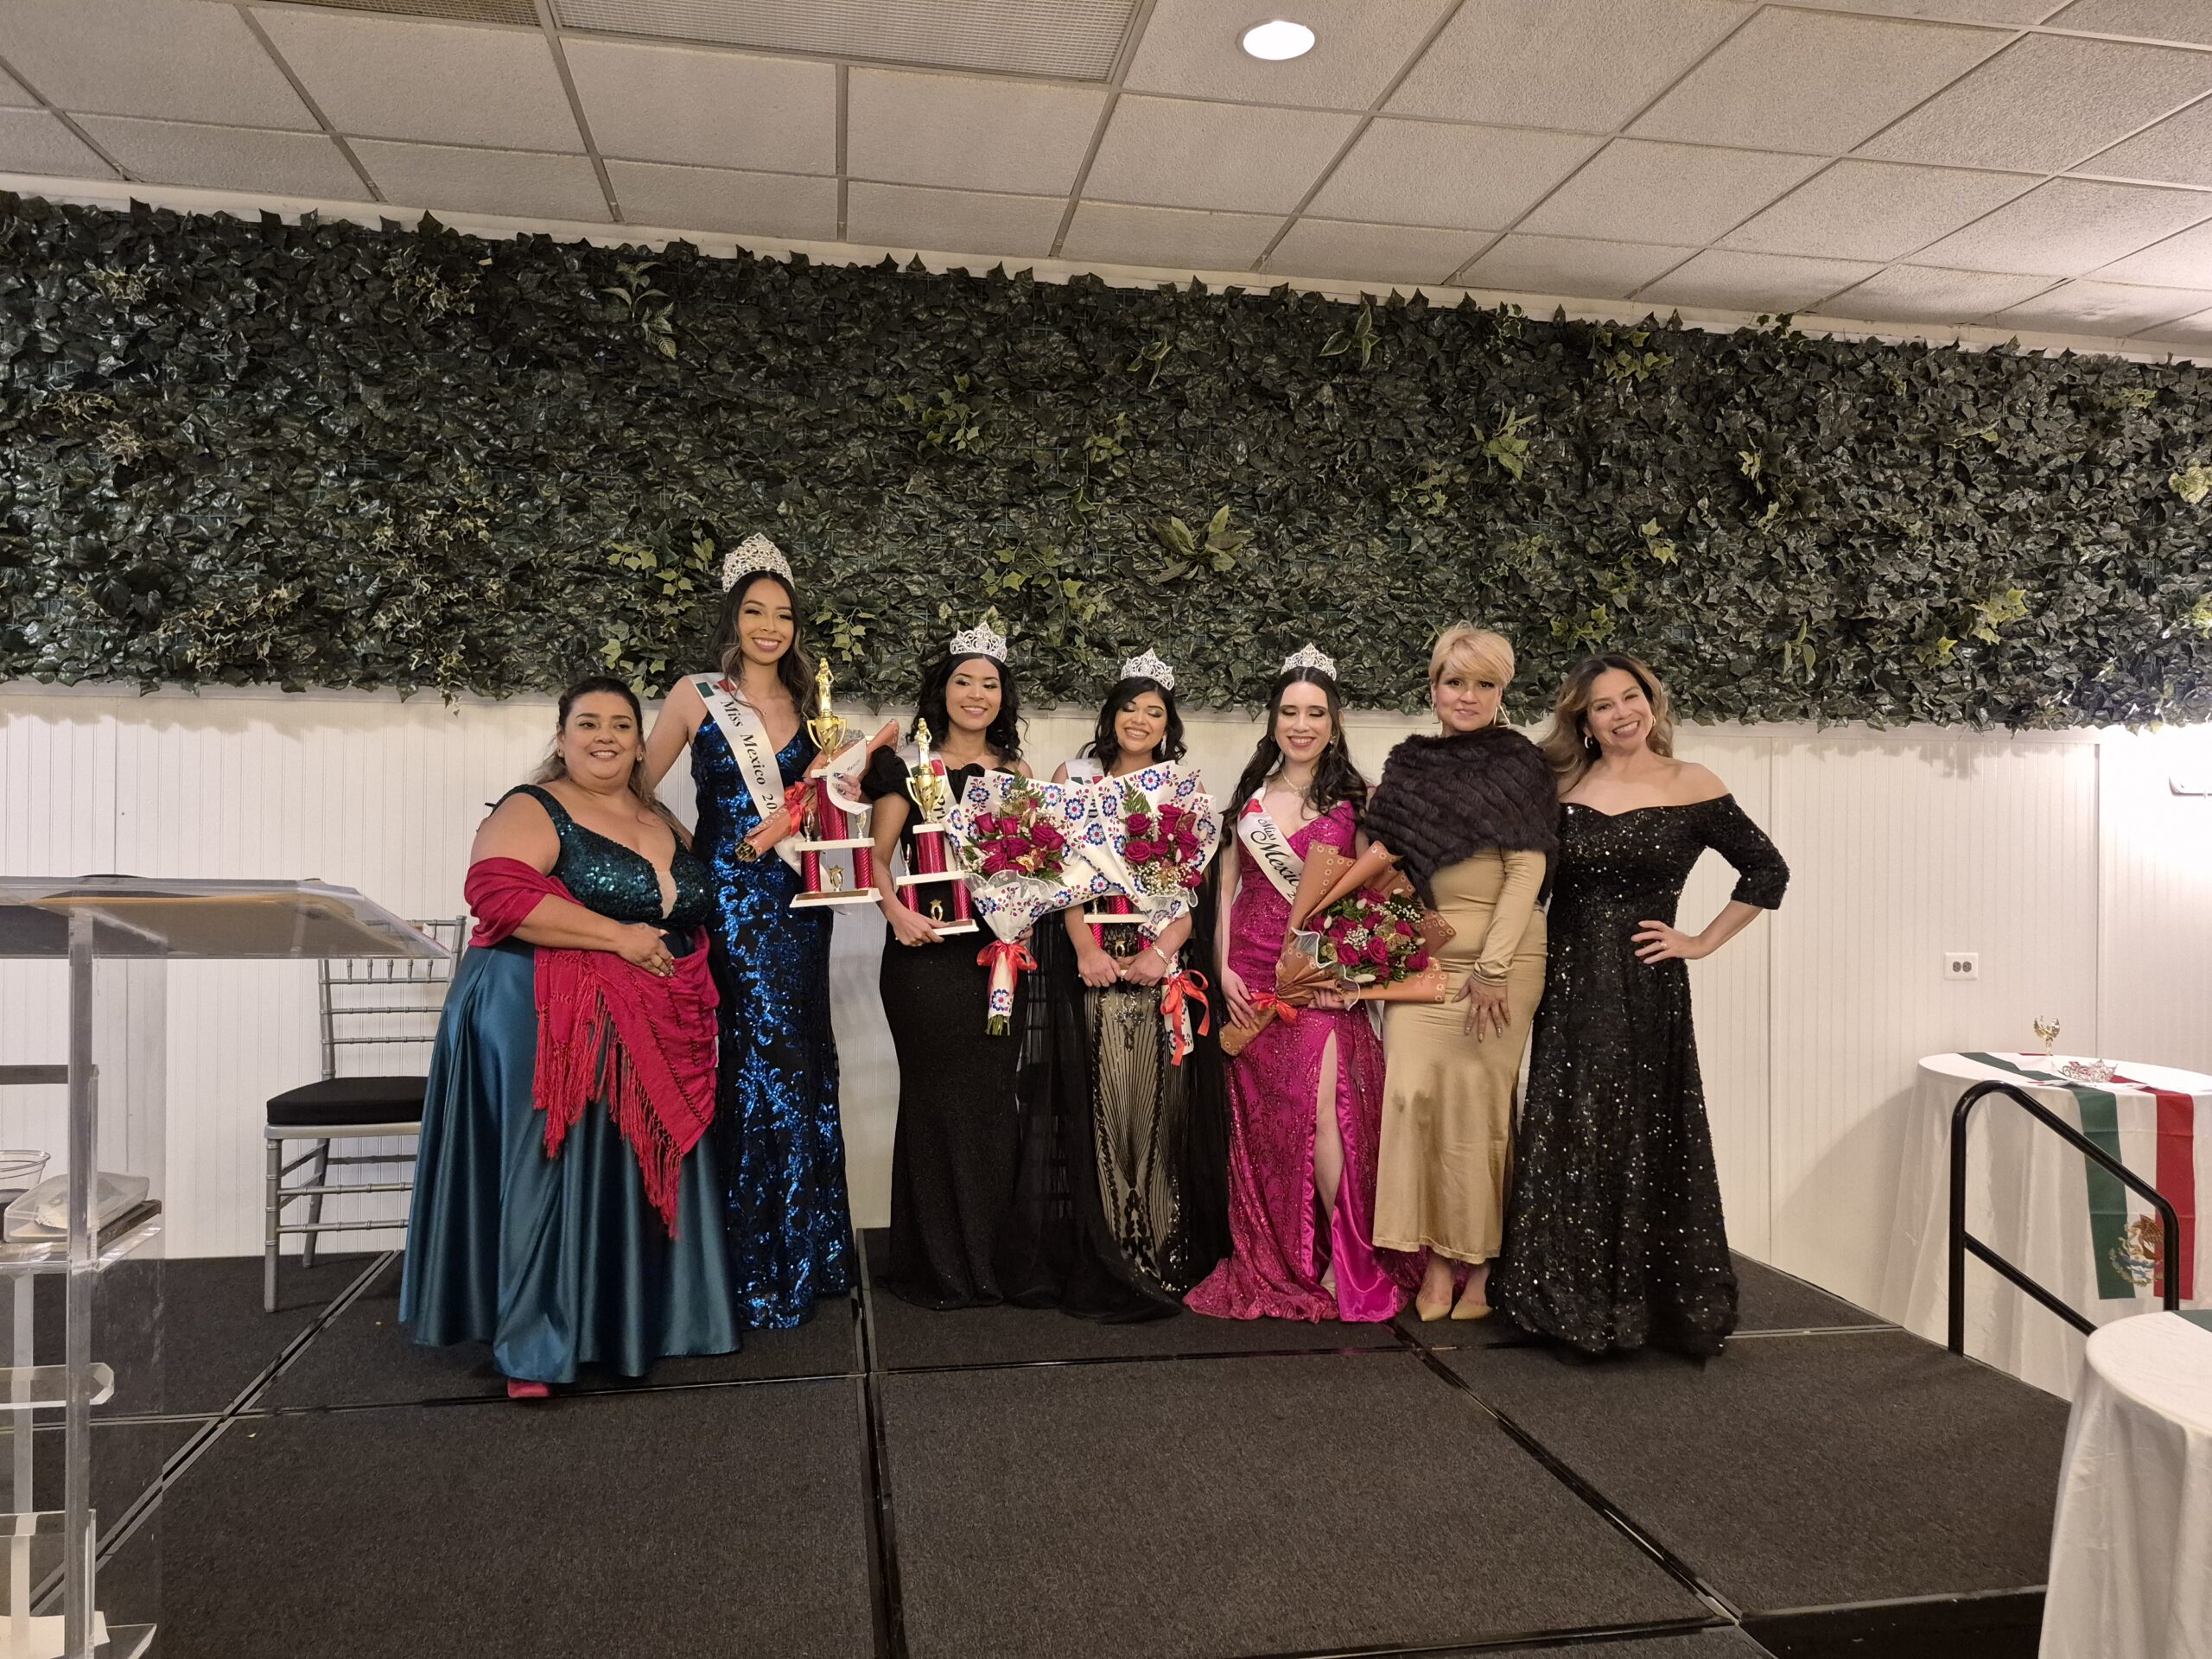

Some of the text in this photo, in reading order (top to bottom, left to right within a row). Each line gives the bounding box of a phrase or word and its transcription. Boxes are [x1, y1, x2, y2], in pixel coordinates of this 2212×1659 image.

[721, 700, 778, 815] Miss Mexico 20
[1257, 818, 1277, 841] Miss
[1250, 830, 1300, 887] Mexic
